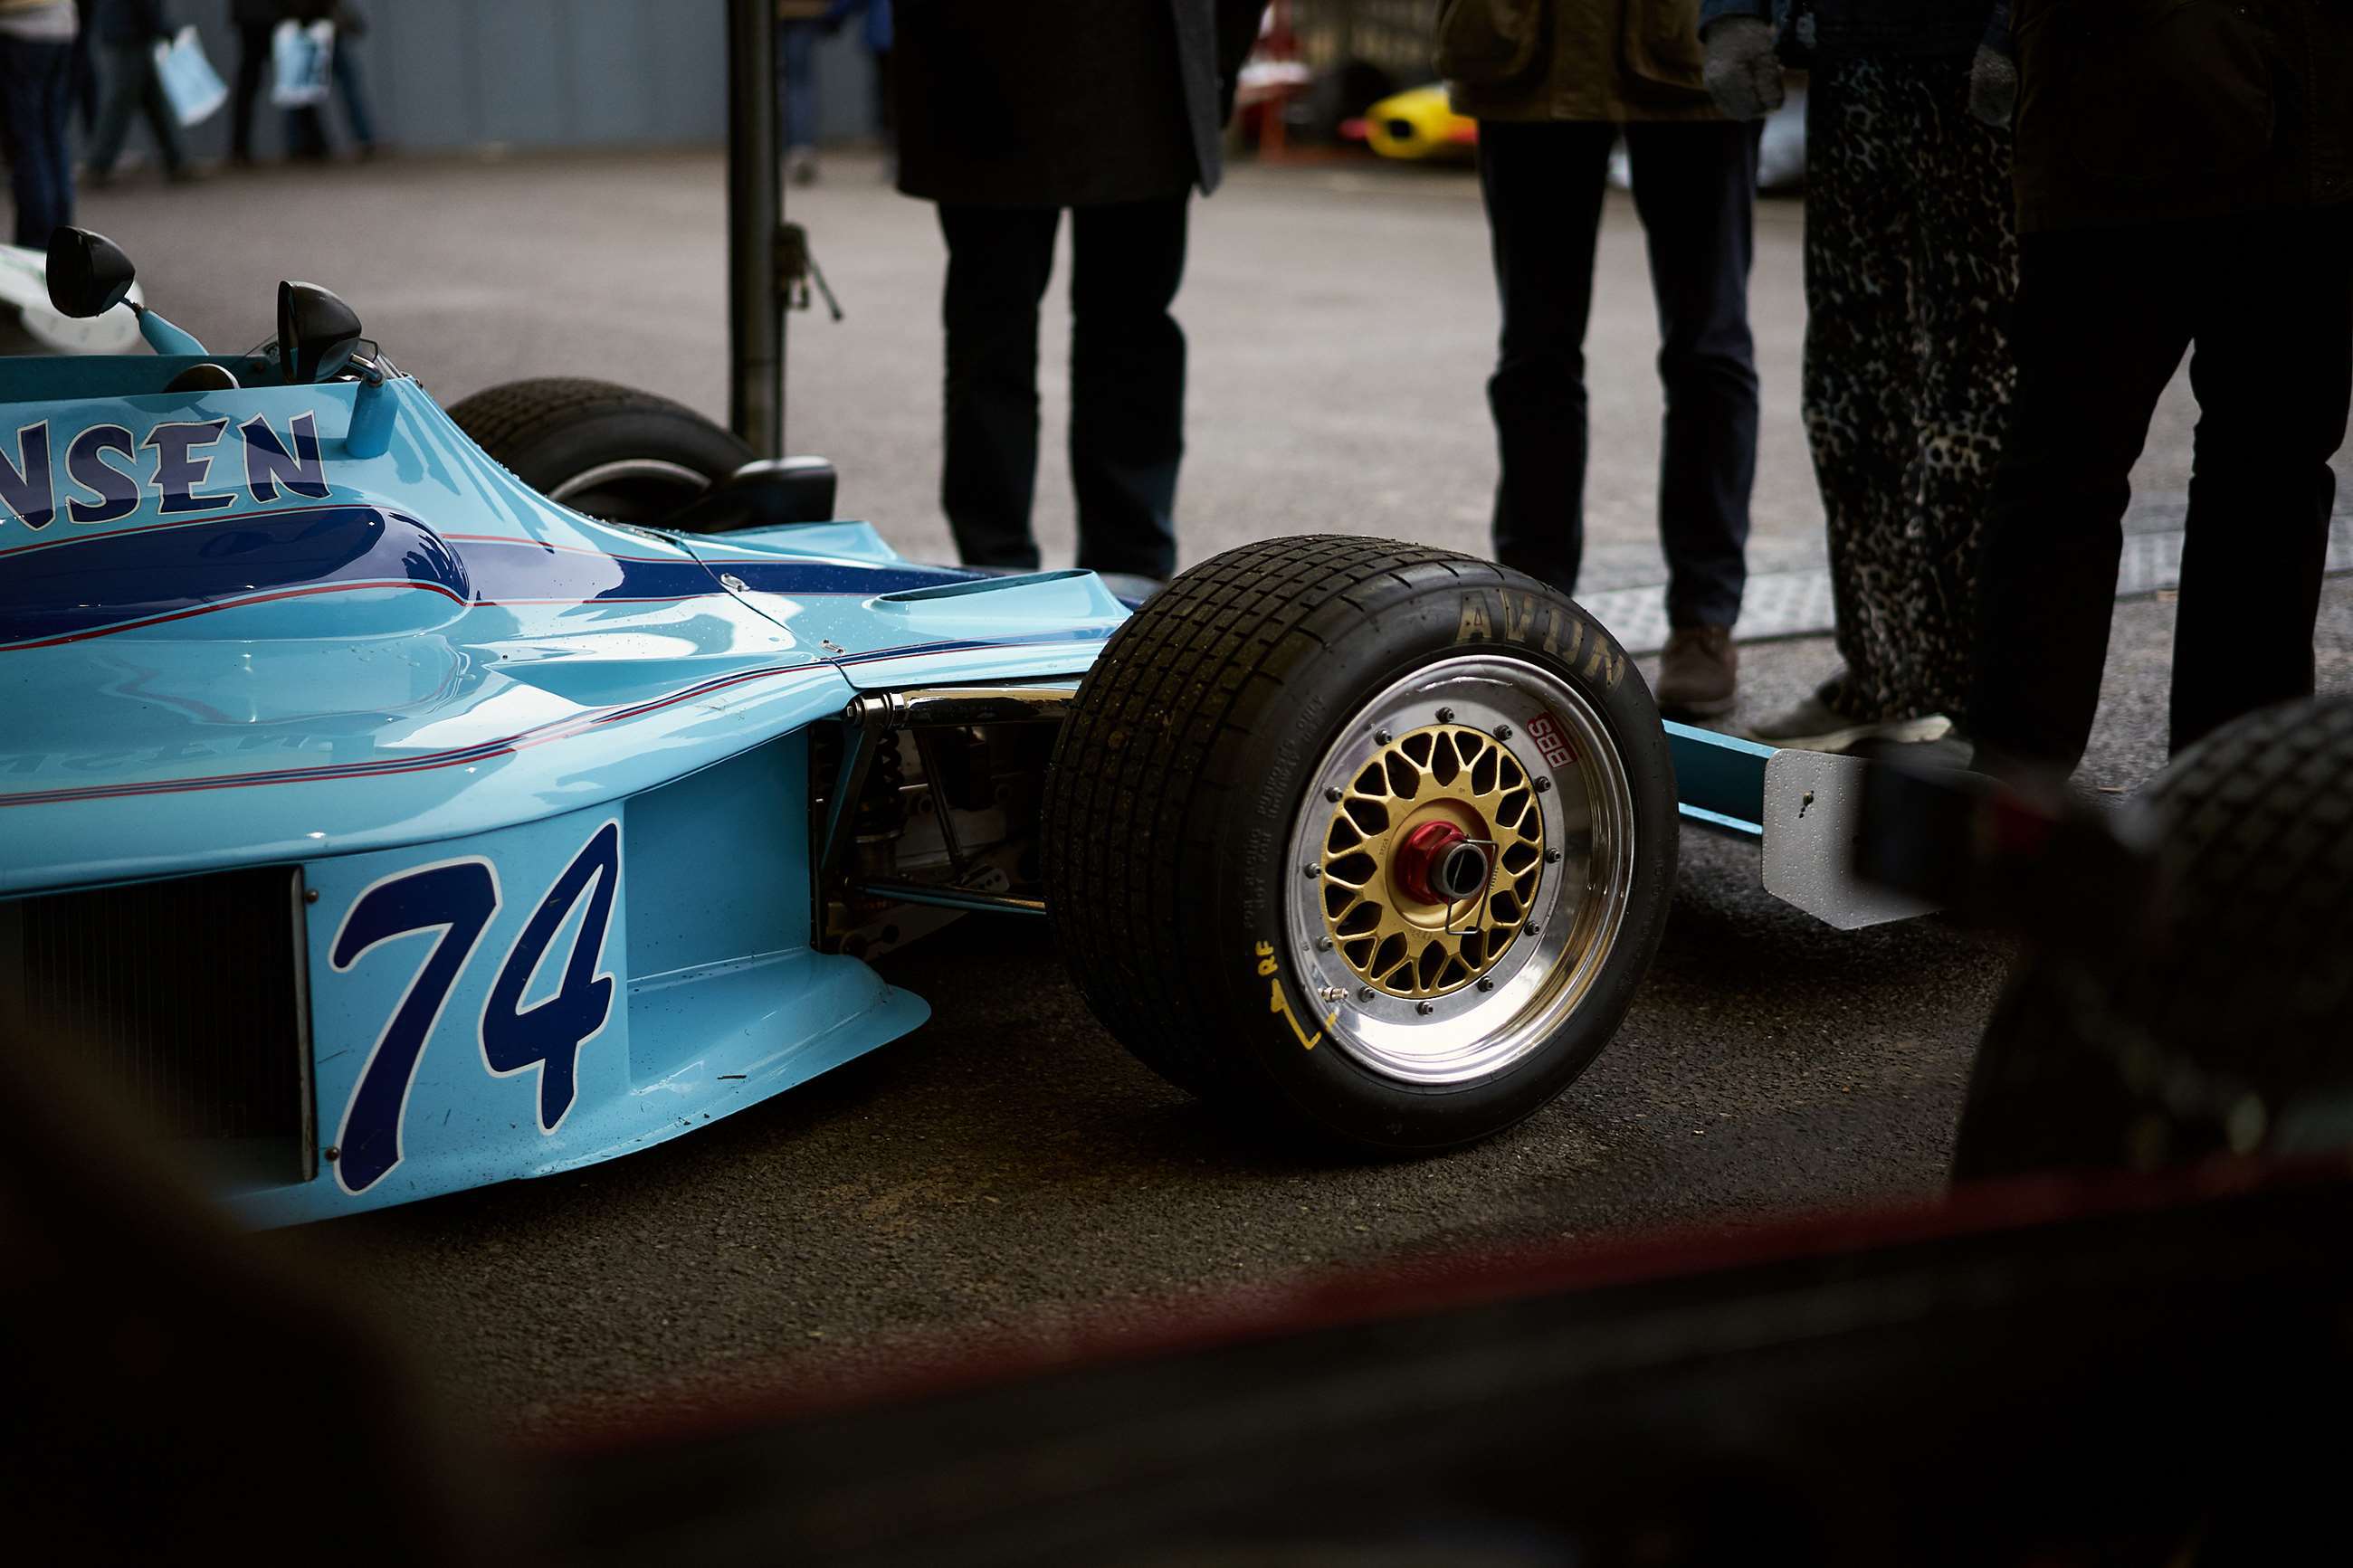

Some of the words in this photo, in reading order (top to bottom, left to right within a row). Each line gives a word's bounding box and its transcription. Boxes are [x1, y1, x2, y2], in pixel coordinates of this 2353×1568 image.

[1455, 588, 1626, 692] AVON
[1528, 717, 1573, 768] BBS
[1255, 940, 1279, 976] RF
[328, 817, 621, 1196] 74
